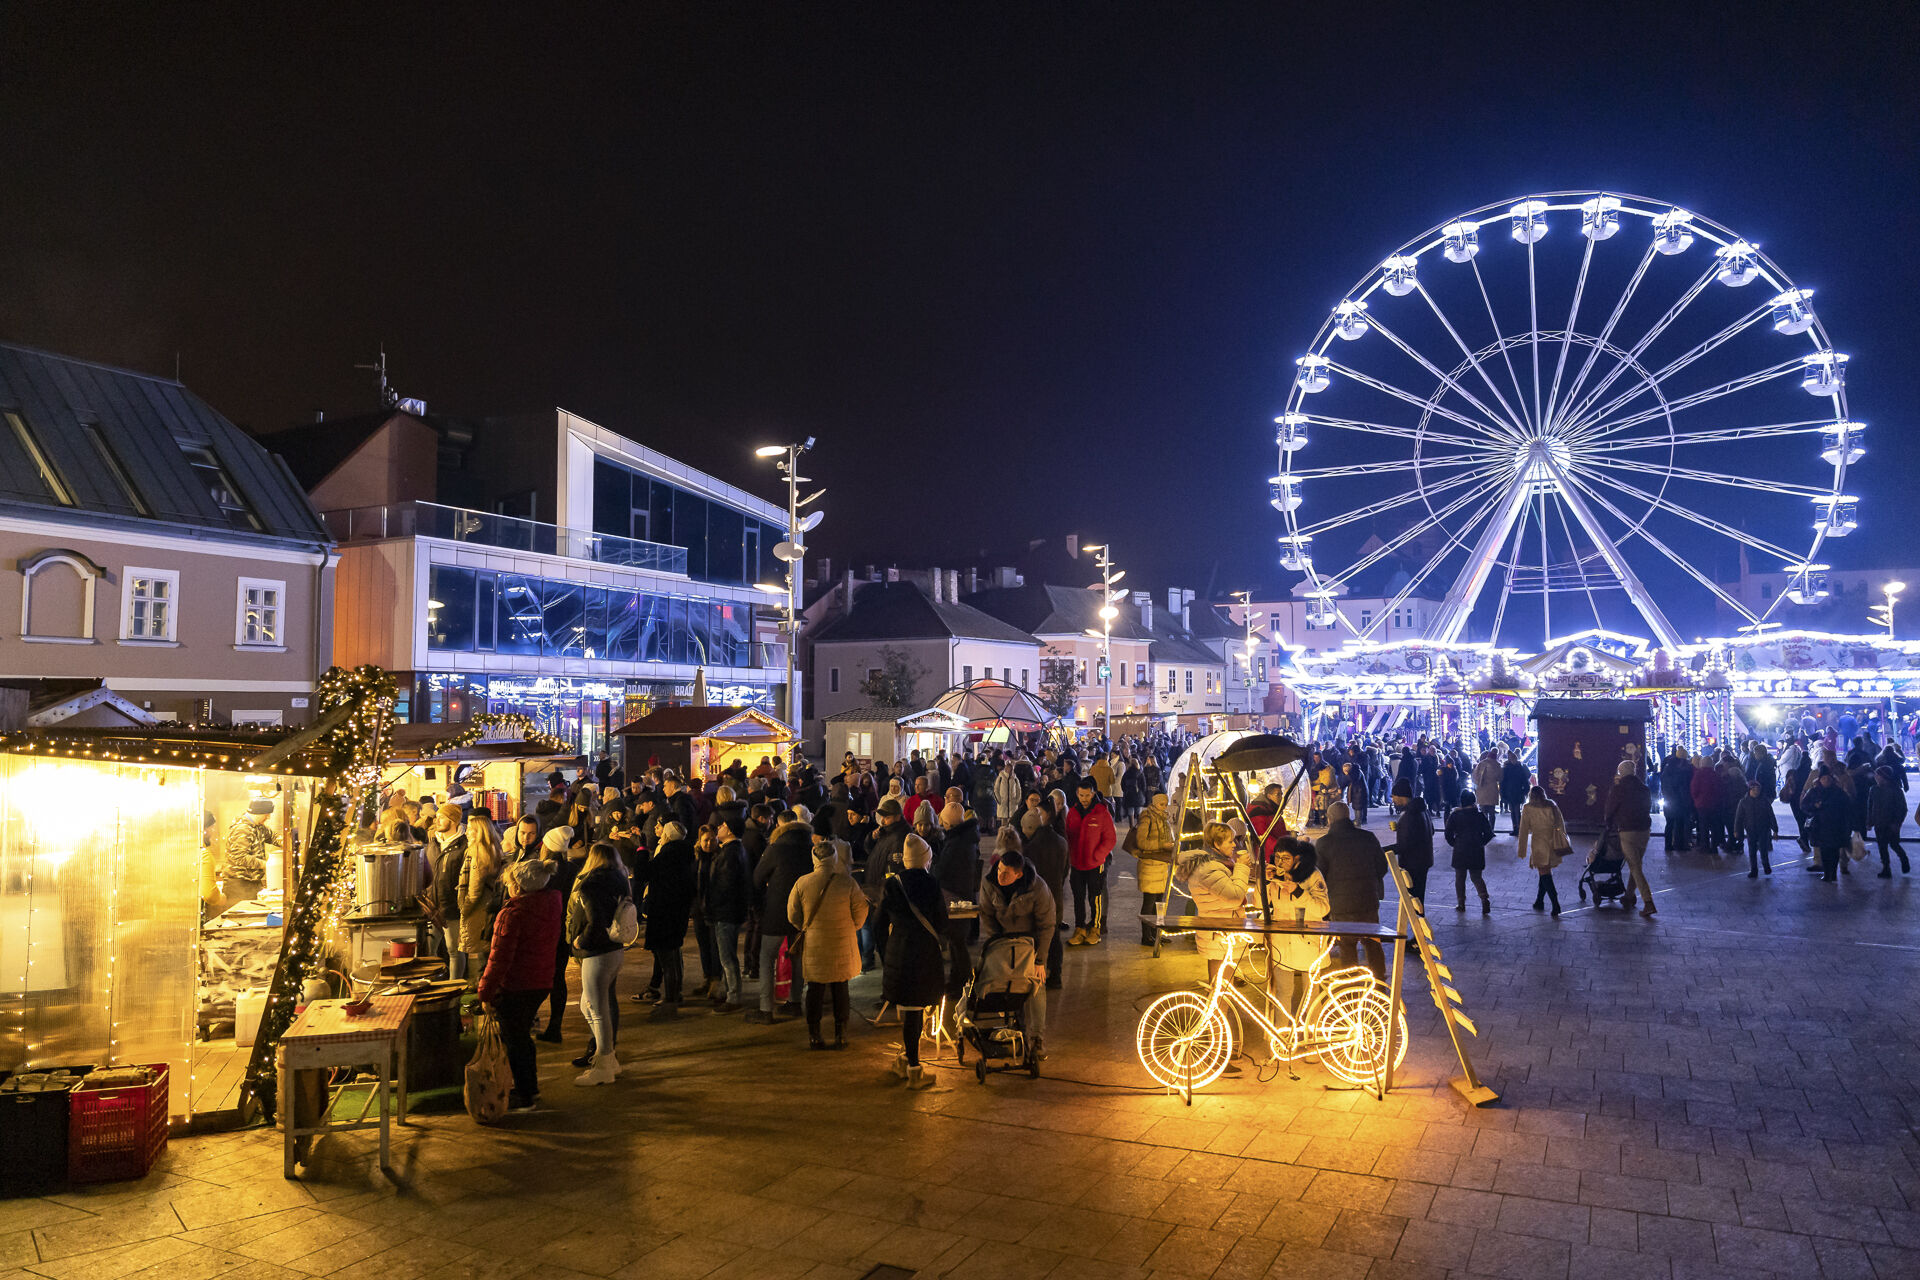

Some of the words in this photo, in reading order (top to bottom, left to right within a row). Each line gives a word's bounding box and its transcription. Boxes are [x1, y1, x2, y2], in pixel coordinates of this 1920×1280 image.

[627, 685, 652, 697] BRADY
[675, 684, 695, 697] BRAD
[1733, 679, 1791, 692] orld
